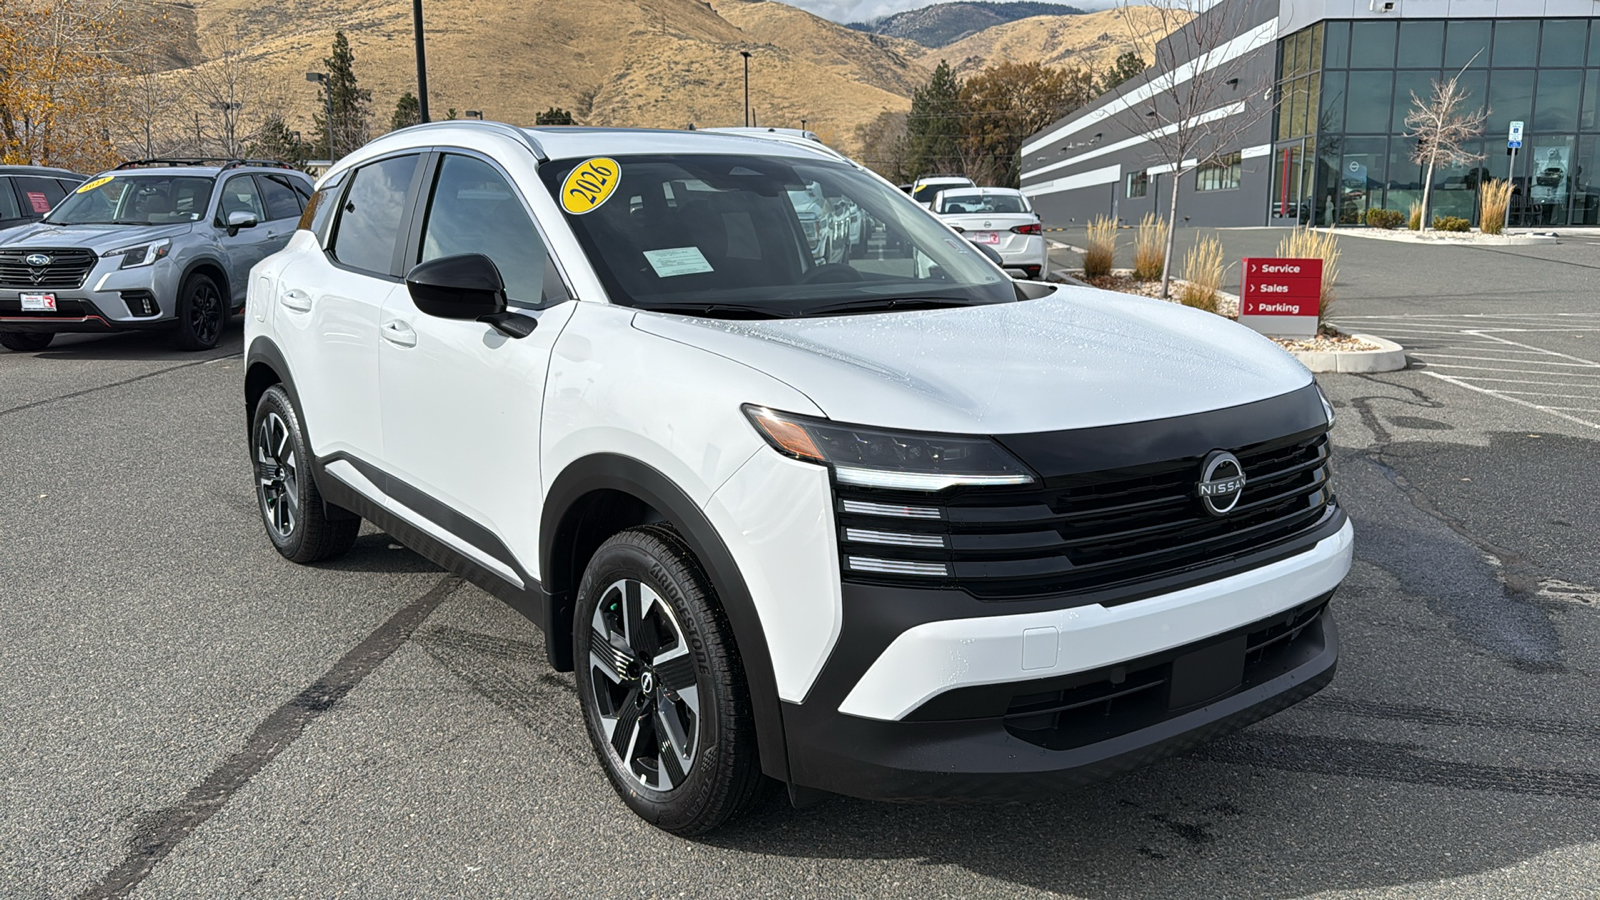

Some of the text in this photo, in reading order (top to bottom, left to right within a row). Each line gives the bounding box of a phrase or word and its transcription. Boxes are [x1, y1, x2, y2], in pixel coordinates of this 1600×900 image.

[570, 161, 612, 205] 2026
[1261, 264, 1301, 274] Service
[1260, 283, 1289, 293] Sales
[1258, 303, 1300, 315] Parking
[1201, 478, 1246, 495] NISSAN
[649, 562, 710, 676] BRIDGESTONE
